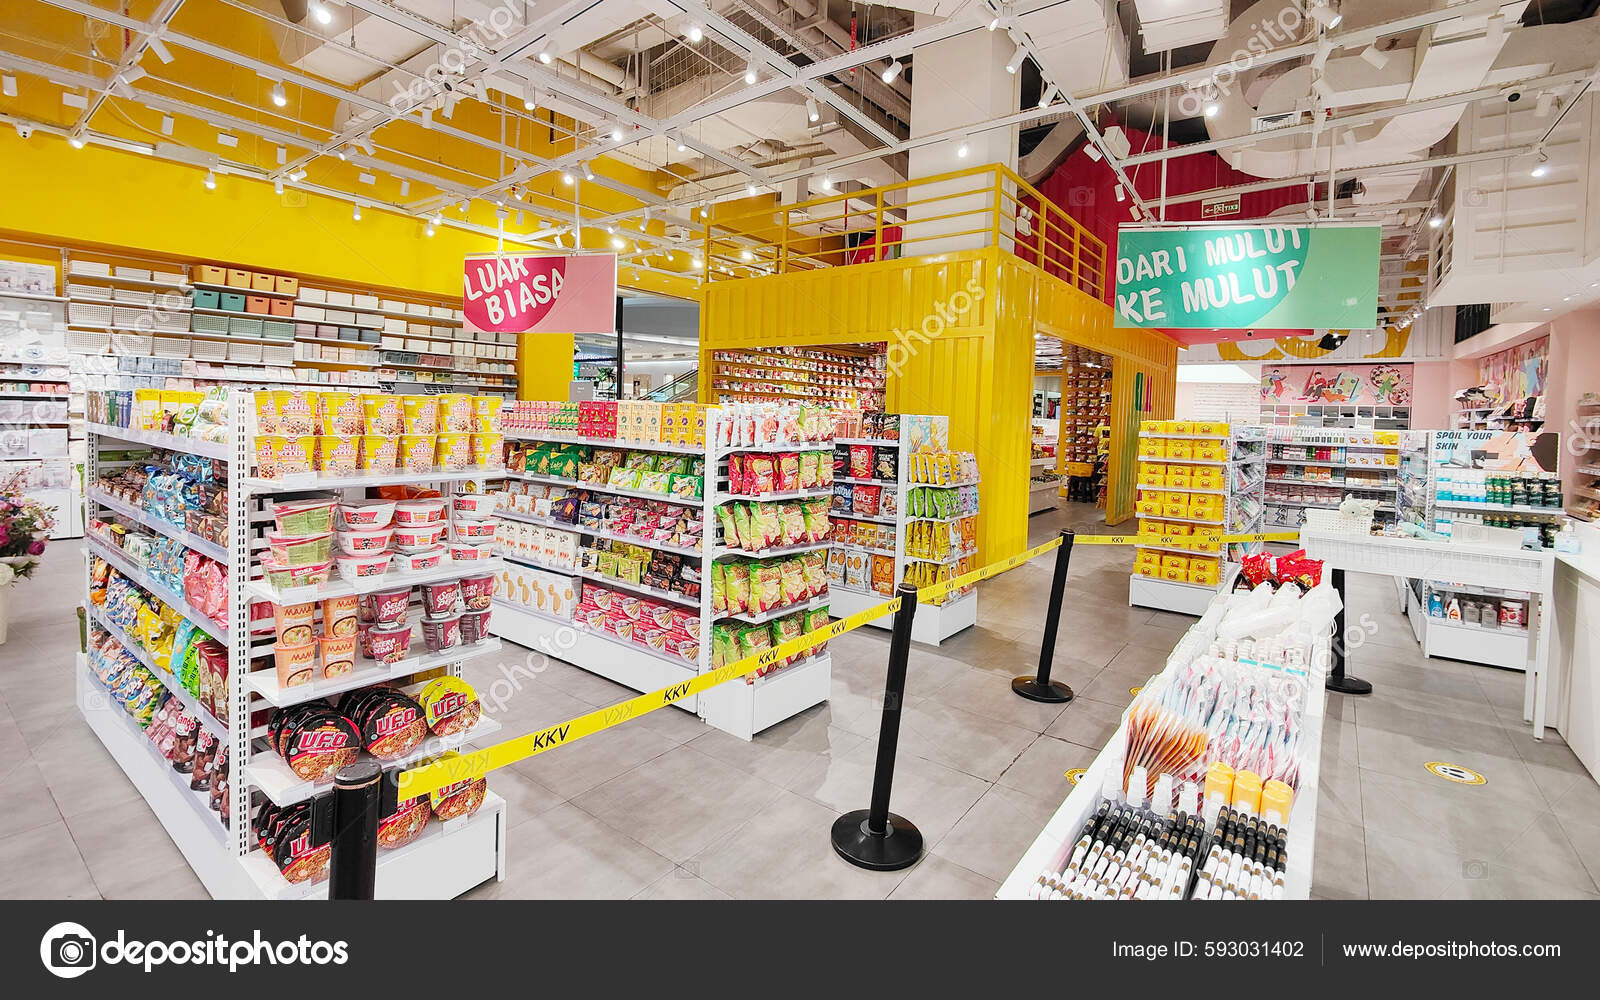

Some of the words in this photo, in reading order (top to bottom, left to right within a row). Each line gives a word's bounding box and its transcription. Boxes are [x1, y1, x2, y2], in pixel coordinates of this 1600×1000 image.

[1117, 246, 1187, 285] DARI
[1205, 224, 1302, 267] MULUT
[464, 256, 529, 301] LUAR
[485, 267, 564, 325] BIASA
[1117, 287, 1167, 324] KE
[1180, 260, 1300, 314] MULUT
[1436, 431, 1463, 440] SPOIL
[1466, 432, 1493, 441] YOUR
[1435, 442, 1458, 450] SKIN
[285, 606, 311, 616] MAMA
[887, 599, 901, 612] KKV
[830, 621, 848, 635] KKV
[328, 643, 353, 651] MAMA
[292, 651, 313, 660] MAM
[758, 648, 780, 665] KKV
[663, 682, 691, 703] KKV
[533, 724, 571, 752] KKV
